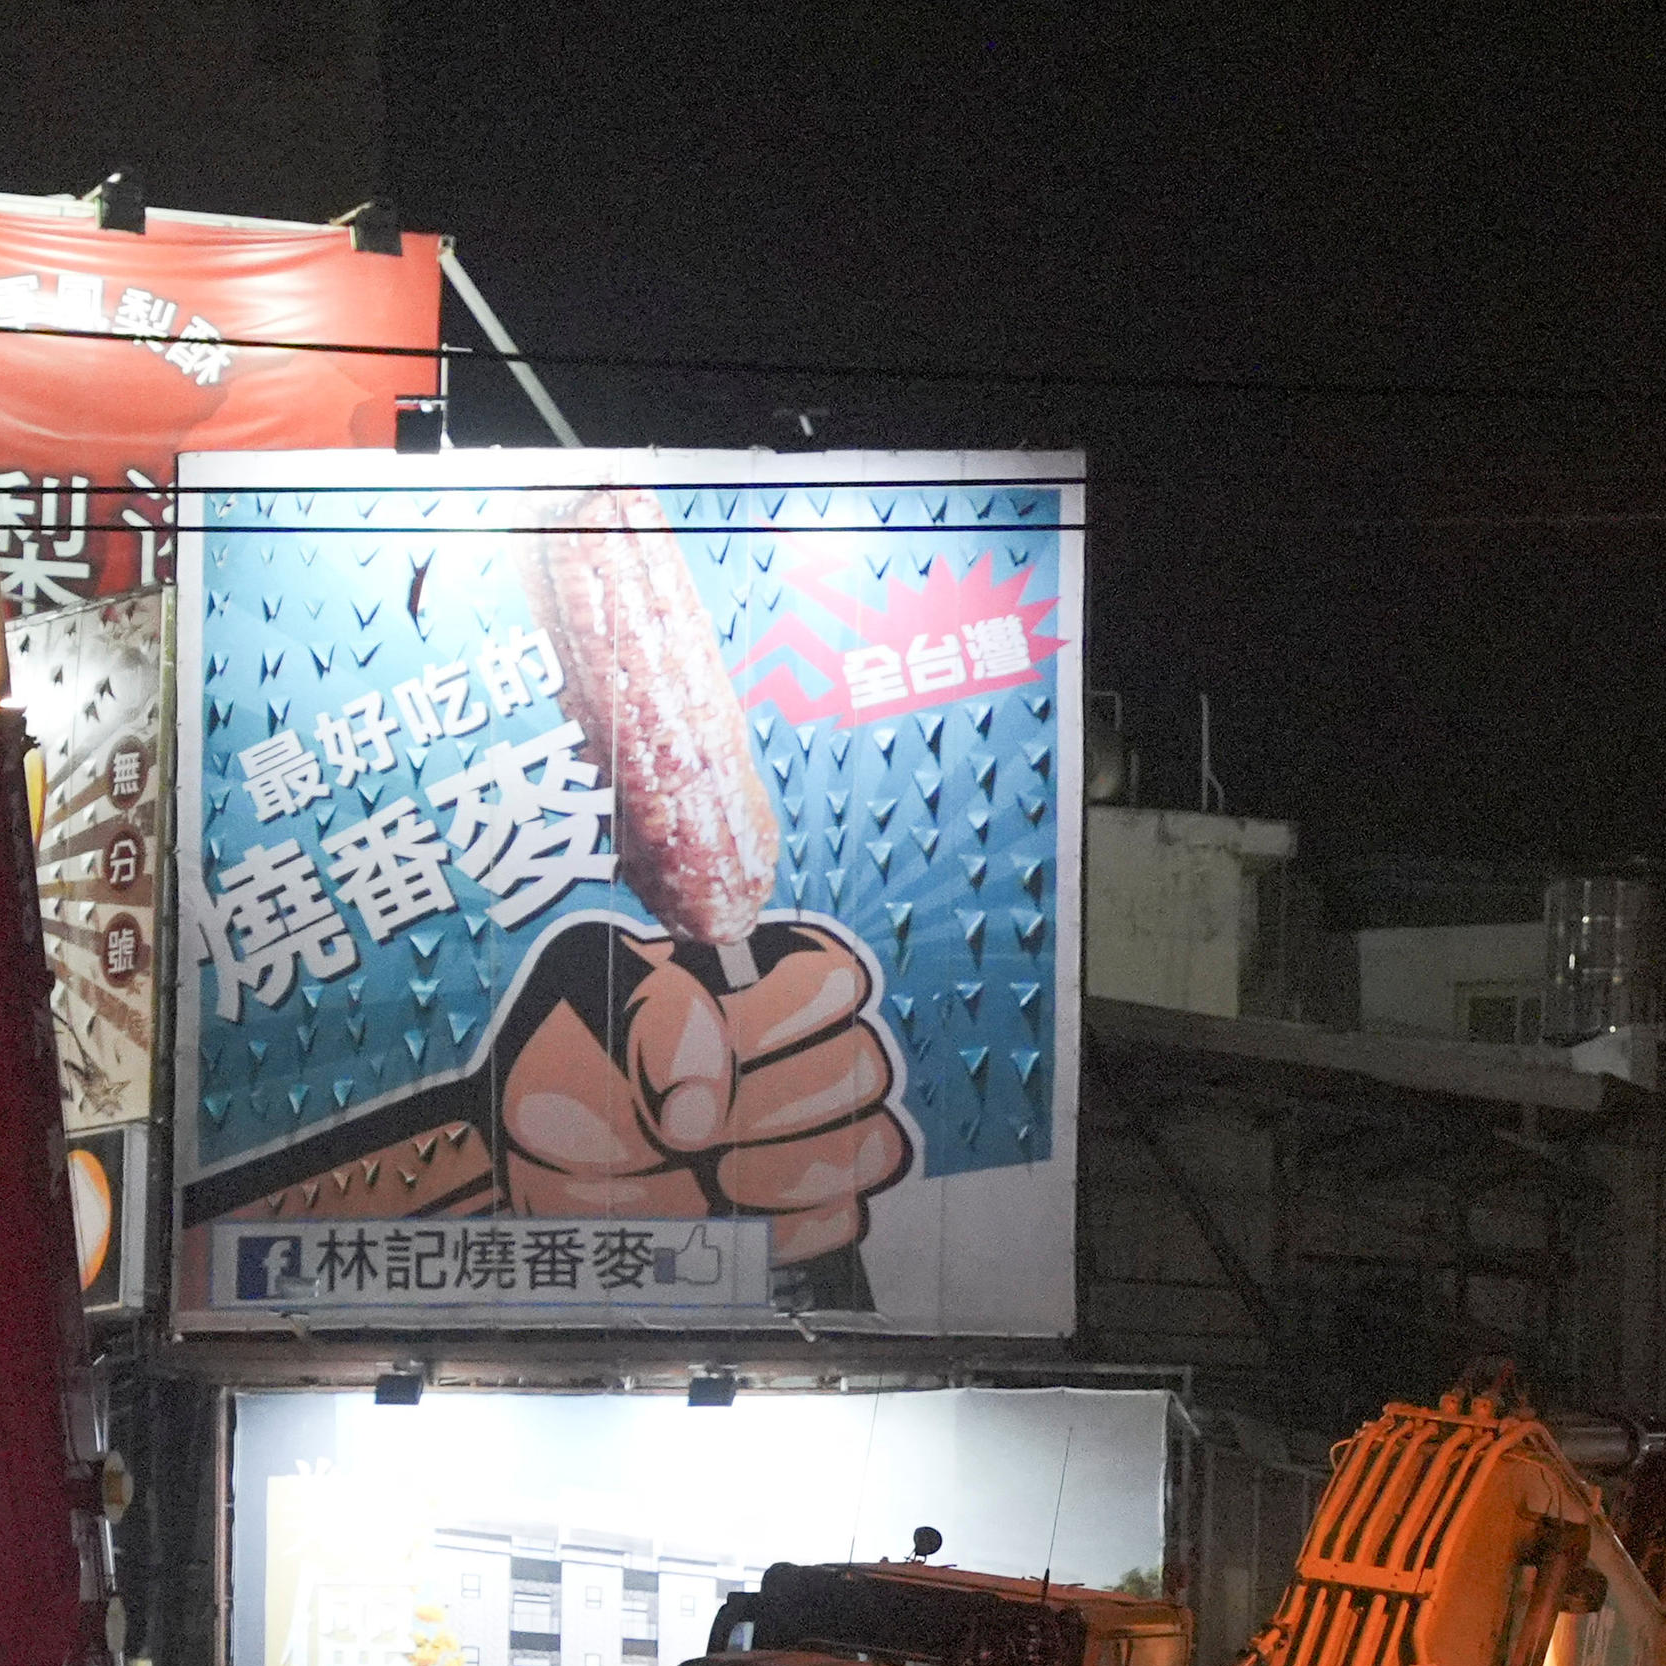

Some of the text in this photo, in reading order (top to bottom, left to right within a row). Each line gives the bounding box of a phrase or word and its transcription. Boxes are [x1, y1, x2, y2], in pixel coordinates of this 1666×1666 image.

[237, 626, 566, 824] 最好吃的
[842, 613, 1035, 712] 全台灣
[192, 720, 620, 1024] 燒番麥
[316, 1227, 656, 1294] 林記燒番麥
